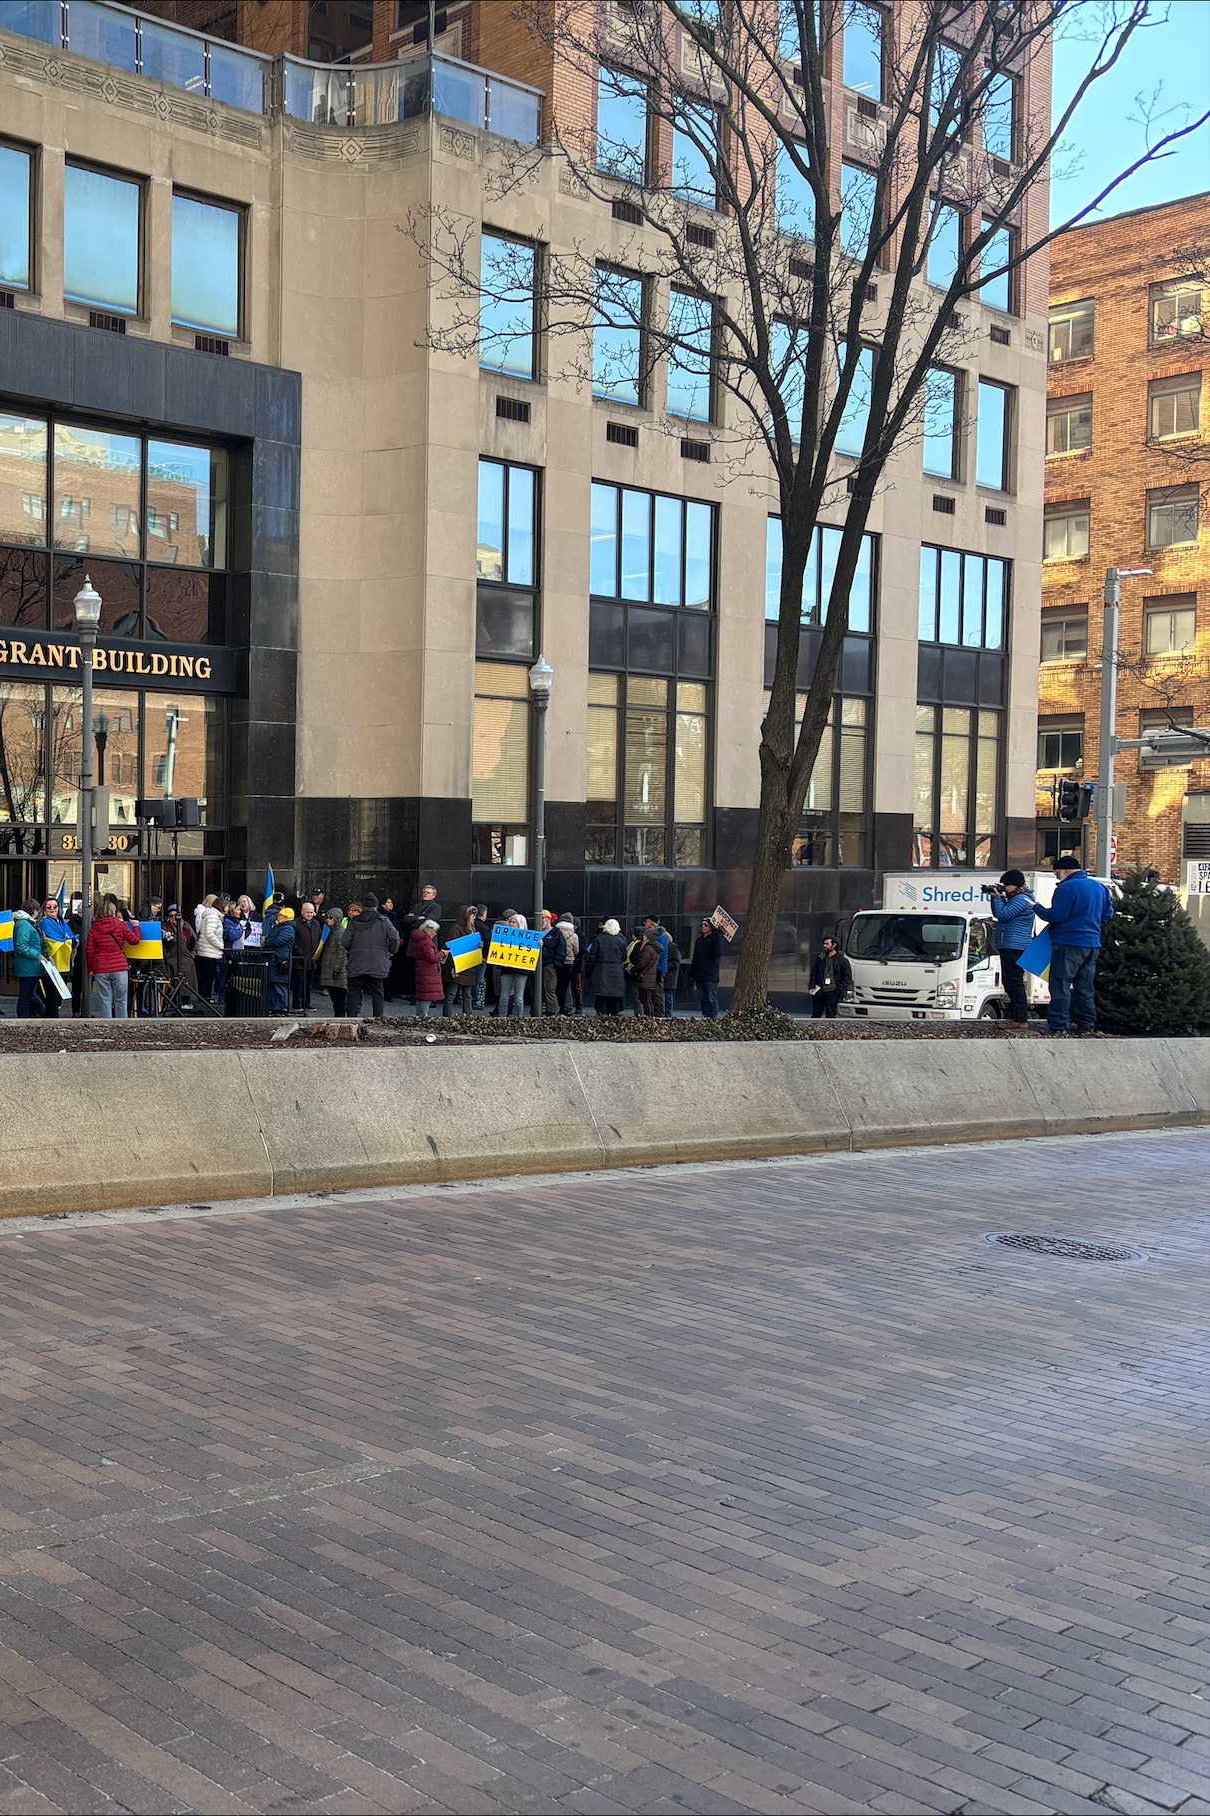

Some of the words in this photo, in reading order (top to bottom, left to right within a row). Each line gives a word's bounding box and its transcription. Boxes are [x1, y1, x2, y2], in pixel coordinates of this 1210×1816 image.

[92, 648, 212, 679] BUILDING
[495, 927, 540, 942] ORANGE
[500, 940, 532, 951] LIES
[491, 950, 535, 964] MATTER
